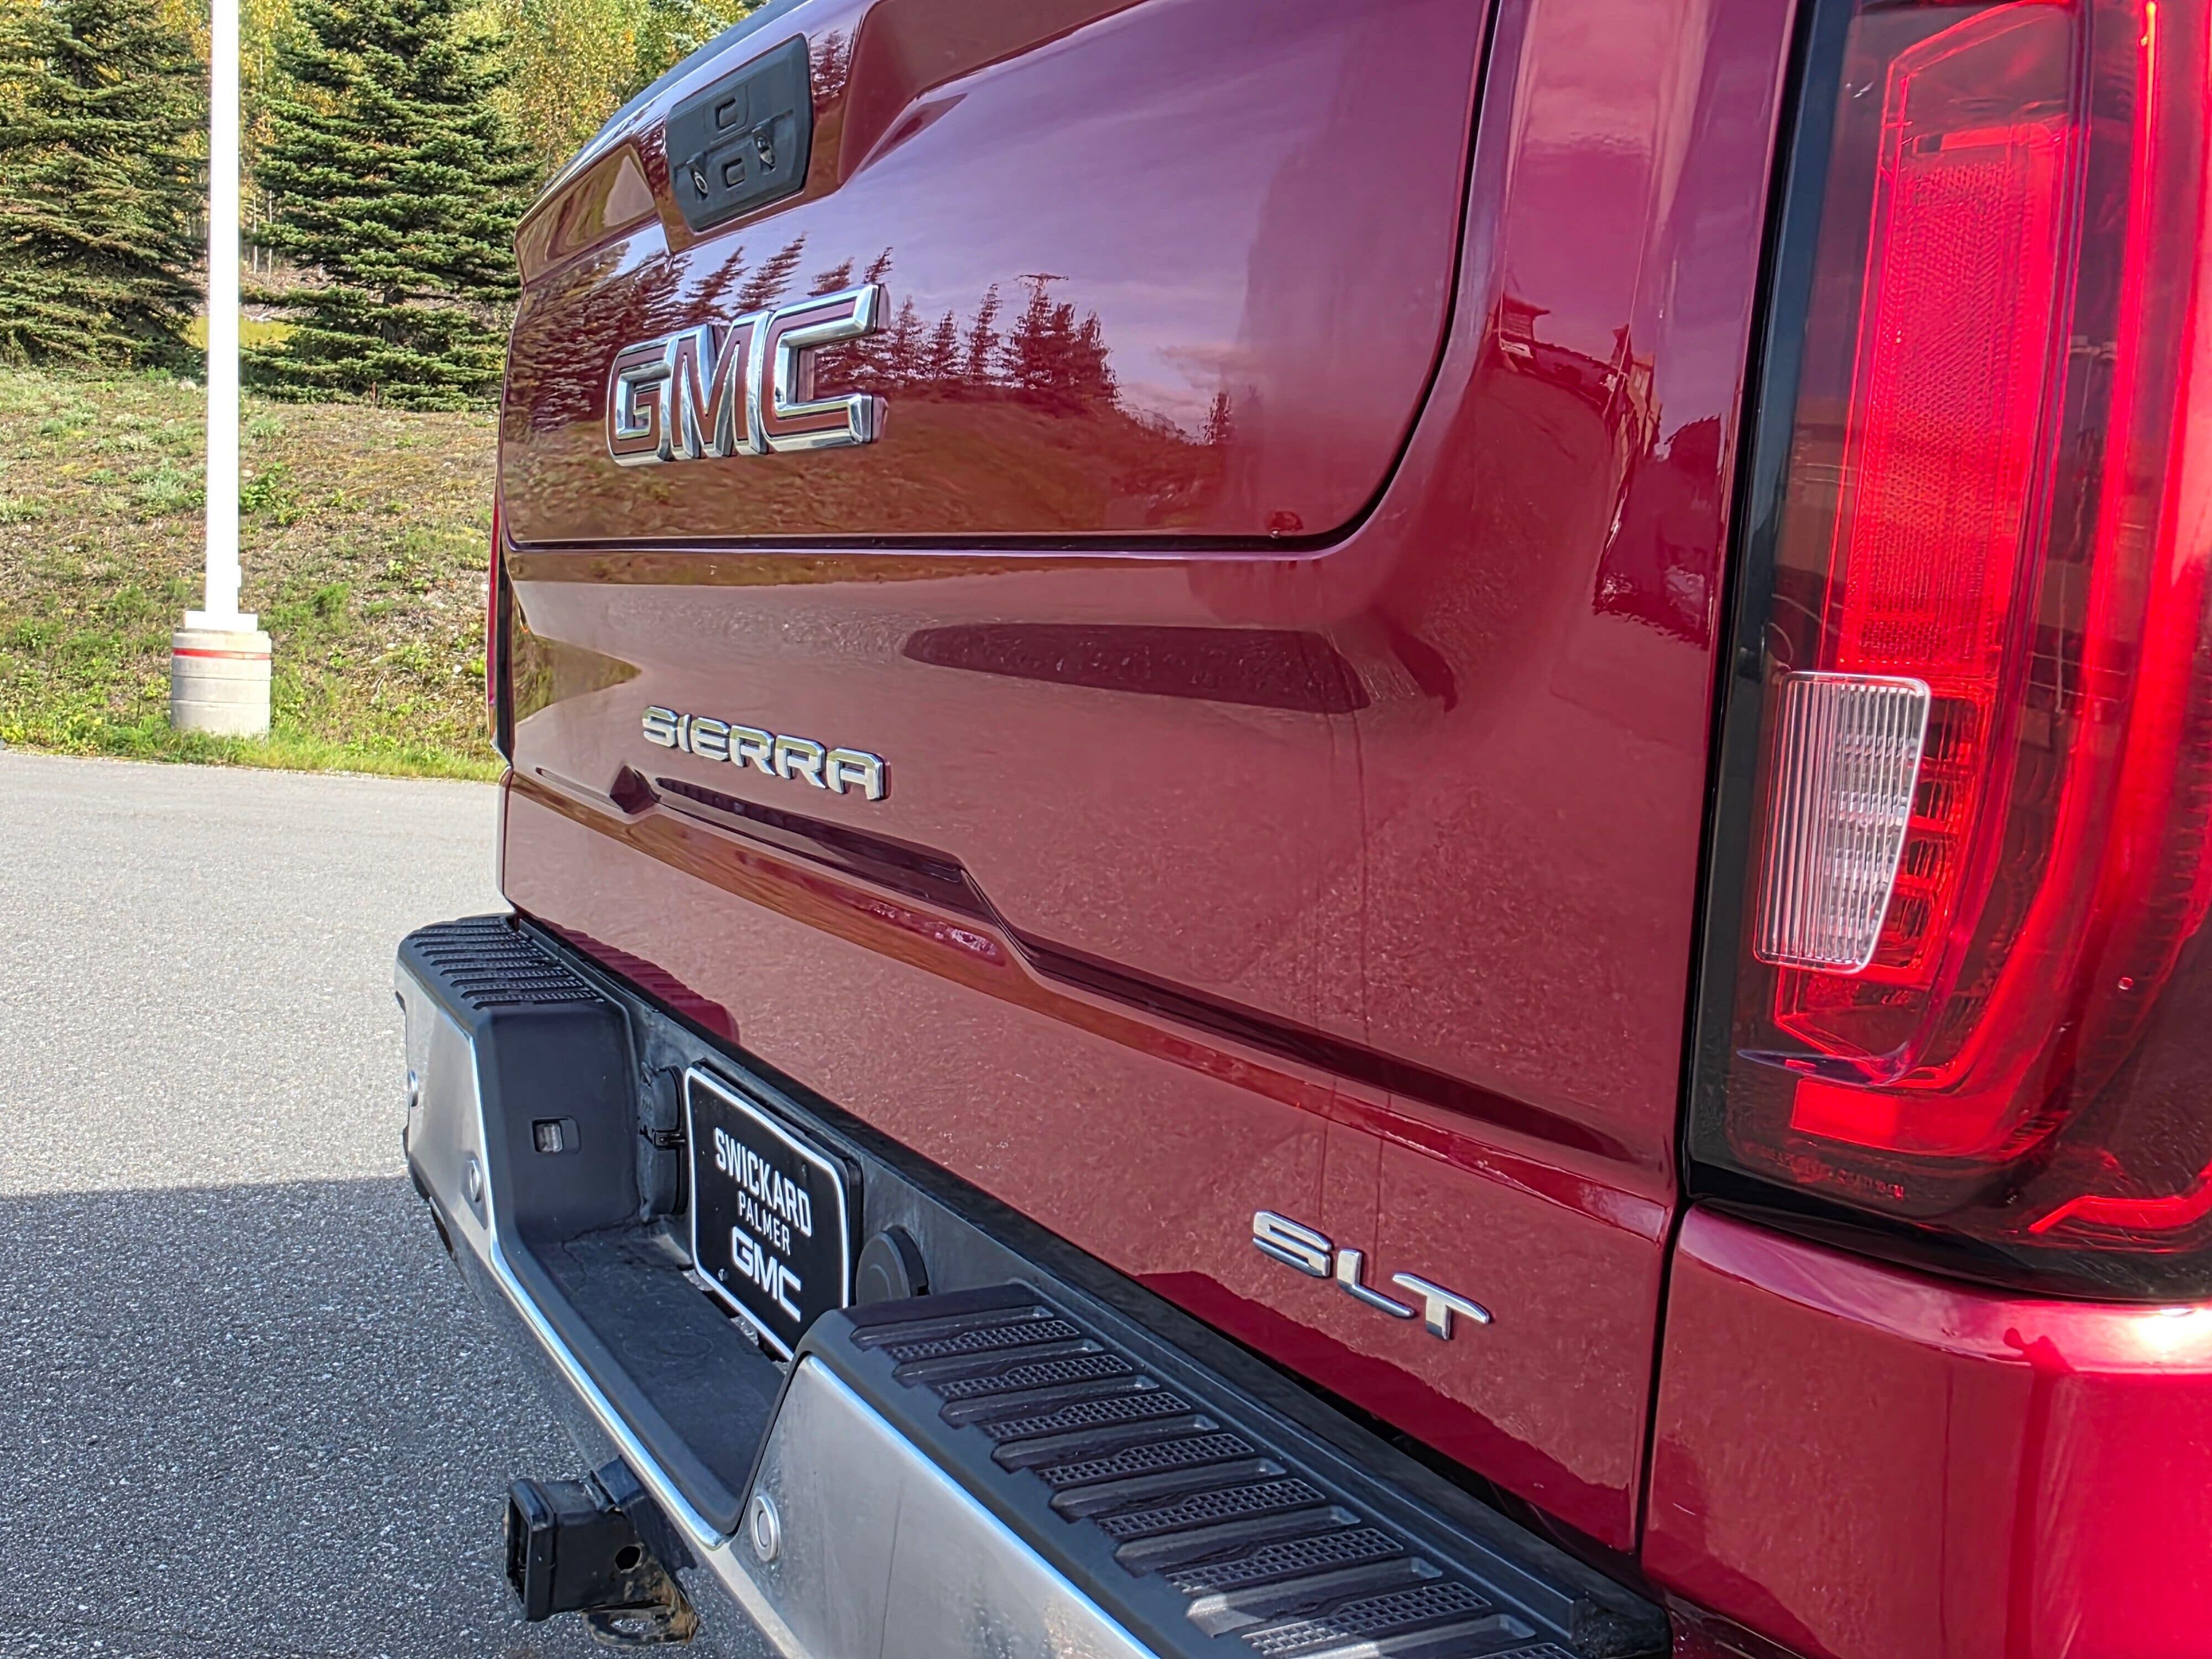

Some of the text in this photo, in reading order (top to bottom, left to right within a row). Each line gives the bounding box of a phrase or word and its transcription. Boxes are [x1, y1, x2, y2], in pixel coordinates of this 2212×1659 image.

[607, 284, 888, 466] GMC
[642, 705, 888, 801] SIERRA
[714, 1127, 812, 1238] SWICKARD
[738, 1191, 791, 1256] PALMER
[732, 1226, 801, 1322] GMC
[1253, 1209, 1491, 1340] SLT
